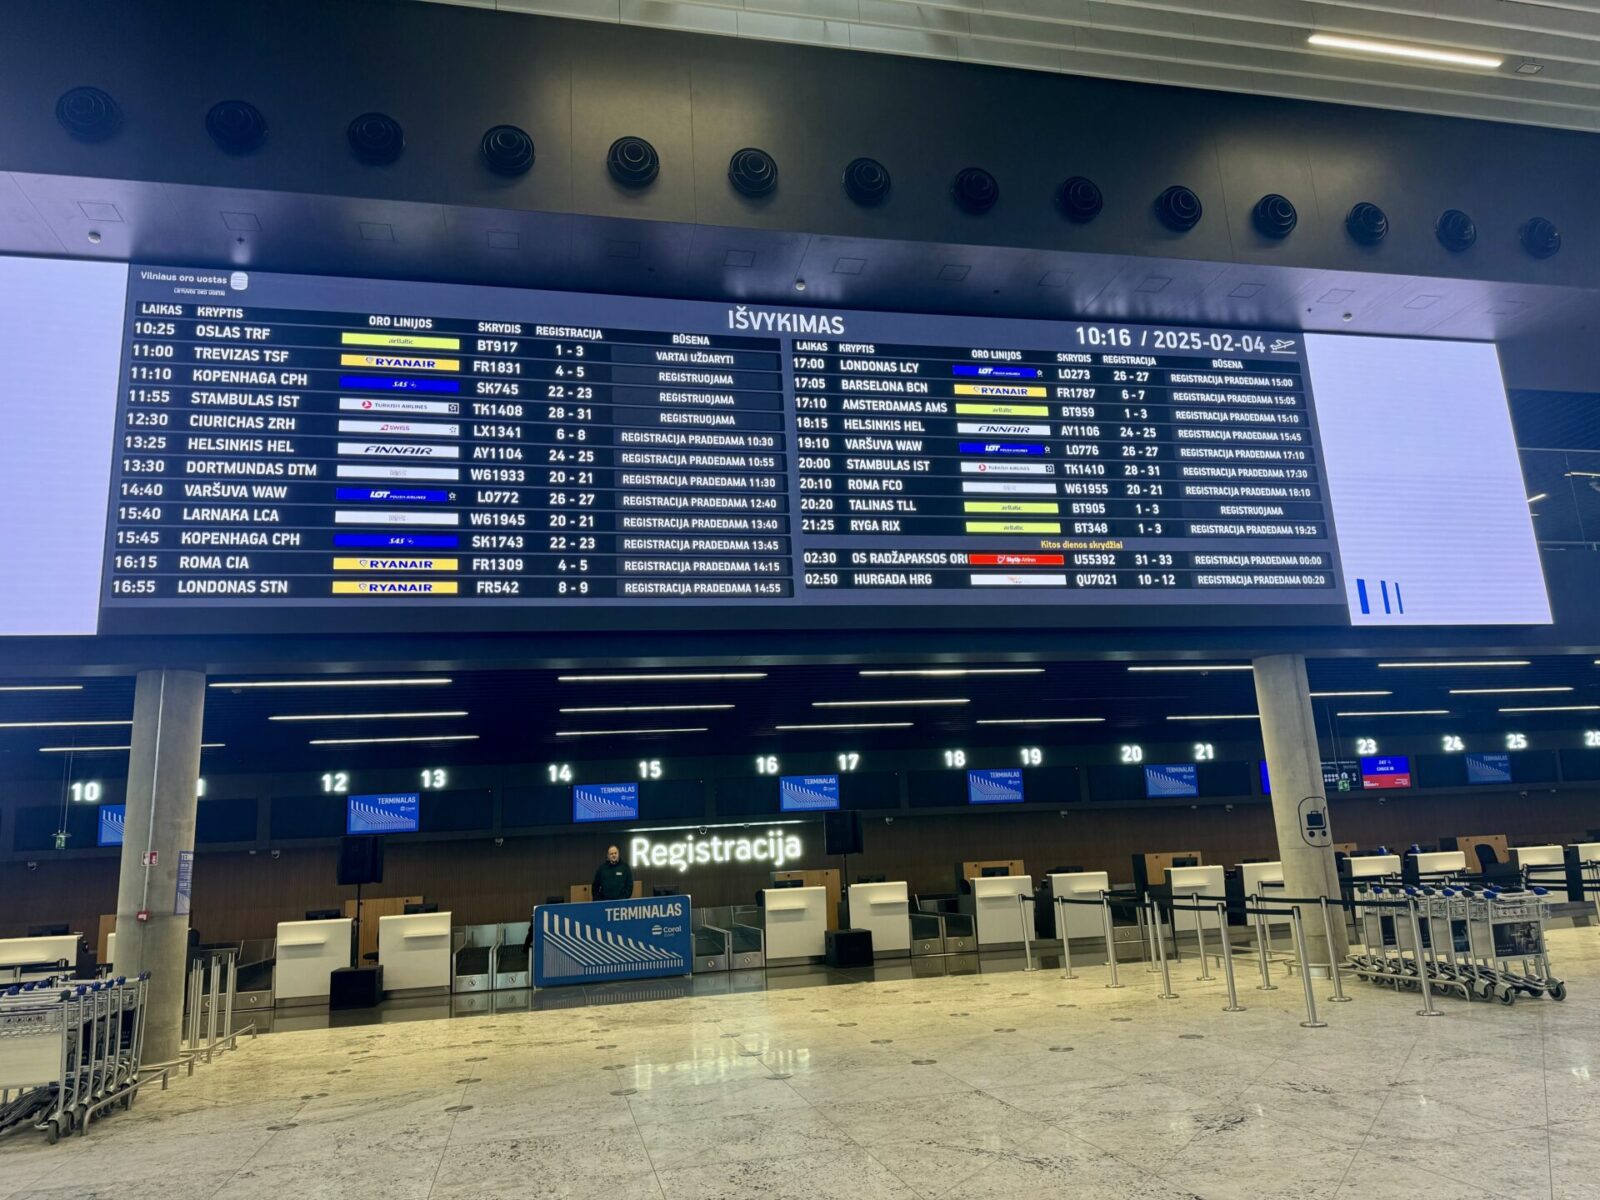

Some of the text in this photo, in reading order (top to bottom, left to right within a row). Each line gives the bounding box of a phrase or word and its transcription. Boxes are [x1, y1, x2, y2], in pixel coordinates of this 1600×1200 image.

[141, 271, 176, 281] Vilniaus
[142, 304, 243, 318] LAIKAS KRYPTIS
[369, 316, 432, 329] ORO LINIJOS
[728, 306, 844, 334] IŠVYKIMAS
[134, 322, 175, 335] 10:25
[196, 325, 270, 340] OSLAS TRF
[478, 322, 522, 334] SKRYDIS
[536, 326, 602, 339] REGISTRACIJA
[477, 339, 518, 353] BT917
[672, 334, 710, 345] BŪSENA
[1076, 327, 1265, 353] 10:16 / 2025-02-04
[132, 345, 173, 358] 11:00
[797, 342, 874, 353] LAIKAS KRYPTIS
[194, 347, 289, 363] TREVIZAS TSF
[656, 352, 734, 365] VARTAI UŽDARYTI
[1057, 354, 1092, 364] SKRYDIS
[1103, 355, 1156, 366] REGISTRACIJA
[376, 357, 436, 368] RYANAIR
[473, 360, 521, 375] FR1831
[793, 358, 824, 369] 17:00
[840, 360, 919, 374] LONDONAS LCY
[131, 368, 172, 380] 11:10
[192, 369, 308, 386] KOPENHAGA CPH
[658, 372, 733, 385] REGISTRUOJAMA
[476, 382, 519, 396] SK745
[794, 378, 825, 388] 17:05
[841, 380, 928, 393] BARSELONA BCN
[128, 390, 170, 403] 11:55
[191, 392, 300, 408] STAMBULAS IST
[1057, 388, 1096, 399] FR1787
[795, 398, 827, 408] 17:10
[842, 400, 947, 412] AMSTERDAMAS AMS
[473, 403, 523, 417] TK1408
[1062, 407, 1095, 418] BT959
[127, 413, 168, 426] 12:30
[189, 415, 295, 430] CIURICHAS ZRH
[796, 418, 828, 428] 18:15
[844, 420, 925, 432] HELSINKIS HEL
[473, 425, 522, 438] LX1341
[1061, 426, 1099, 437] AY1106
[125, 436, 166, 449] 13:25
[188, 438, 294, 452] HELSINKIS HEL
[798, 438, 829, 448] 19:10
[845, 437, 922, 451] VARŠUVA WAW
[364, 446, 432, 455] FINNAIR
[473, 447, 523, 460] AY1104
[122, 460, 164, 473] 13:30
[186, 461, 317, 476] DORTMUNDAS DTM
[799, 458, 830, 469] 20:00
[846, 460, 930, 472] STAMBULAS IST
[1065, 464, 1104, 475] TK1410
[470, 469, 525, 482] W61933
[121, 483, 163, 496] 14:40
[184, 482, 288, 499] VARŠUVA WAW
[800, 479, 832, 489] 20:10
[848, 480, 902, 491] ROMA FCO
[1065, 484, 1108, 494] W61955
[370, 491, 389, 499] LOT
[801, 500, 833, 510] 20:20
[849, 500, 916, 511] TALINAS TLL
[1072, 503, 1105, 514] BT905
[1221, 505, 1283, 516] REGISTRUOJAMA
[118, 507, 161, 520] 15:40
[183, 508, 279, 522] LARNAKA LCA
[470, 513, 526, 526] W61945
[802, 520, 834, 530] 21:25
[851, 521, 900, 532] RYGA RIX
[1075, 523, 1108, 534] BT348
[117, 532, 159, 544] 15:45
[181, 532, 300, 546] KOPENHAGA CPH
[472, 536, 523, 548] SK1743
[1041, 540, 1123, 550] Kitos dienos skrydžiai
[114, 556, 157, 569] 16:15
[179, 556, 249, 569] ROMA CIA
[804, 553, 836, 564] 02:30
[852, 554, 866, 564] OS
[870, 550, 946, 564] RADŽAPAKSOS
[1074, 554, 1115, 565] U55392
[472, 558, 523, 571] FR1309
[805, 574, 838, 584] 02:50
[854, 574, 932, 585] HURGADA HRG
[1076, 574, 1117, 586] QU7021
[1198, 575, 1324, 586] REGISTRACIJA PRADEDAMA 00:20
[112, 580, 155, 593] 16:55
[178, 580, 288, 593] LONDONAS STN
[477, 581, 519, 594] FR542
[625, 582, 781, 597] REGISTRACIJA PRADEDAMA 14:55
[1357, 738, 1377, 754] 23
[1443, 736, 1464, 751] 24
[1506, 734, 1527, 749] 25
[944, 751, 965, 766] 18
[1022, 749, 1041, 765] 19
[1122, 746, 1142, 762] 20
[1195, 744, 1213, 760] 21
[756, 757, 778, 774] 16
[838, 754, 860, 771] 17
[549, 765, 572, 782] 14
[640, 760, 661, 779] 15
[322, 773, 348, 791] 12
[421, 769, 446, 788] 13
[72, 782, 99, 801] 10
[630, 829, 801, 872] Registracija
[605, 903, 682, 921] TERMINALAS
[663, 924, 682, 934] Coral
